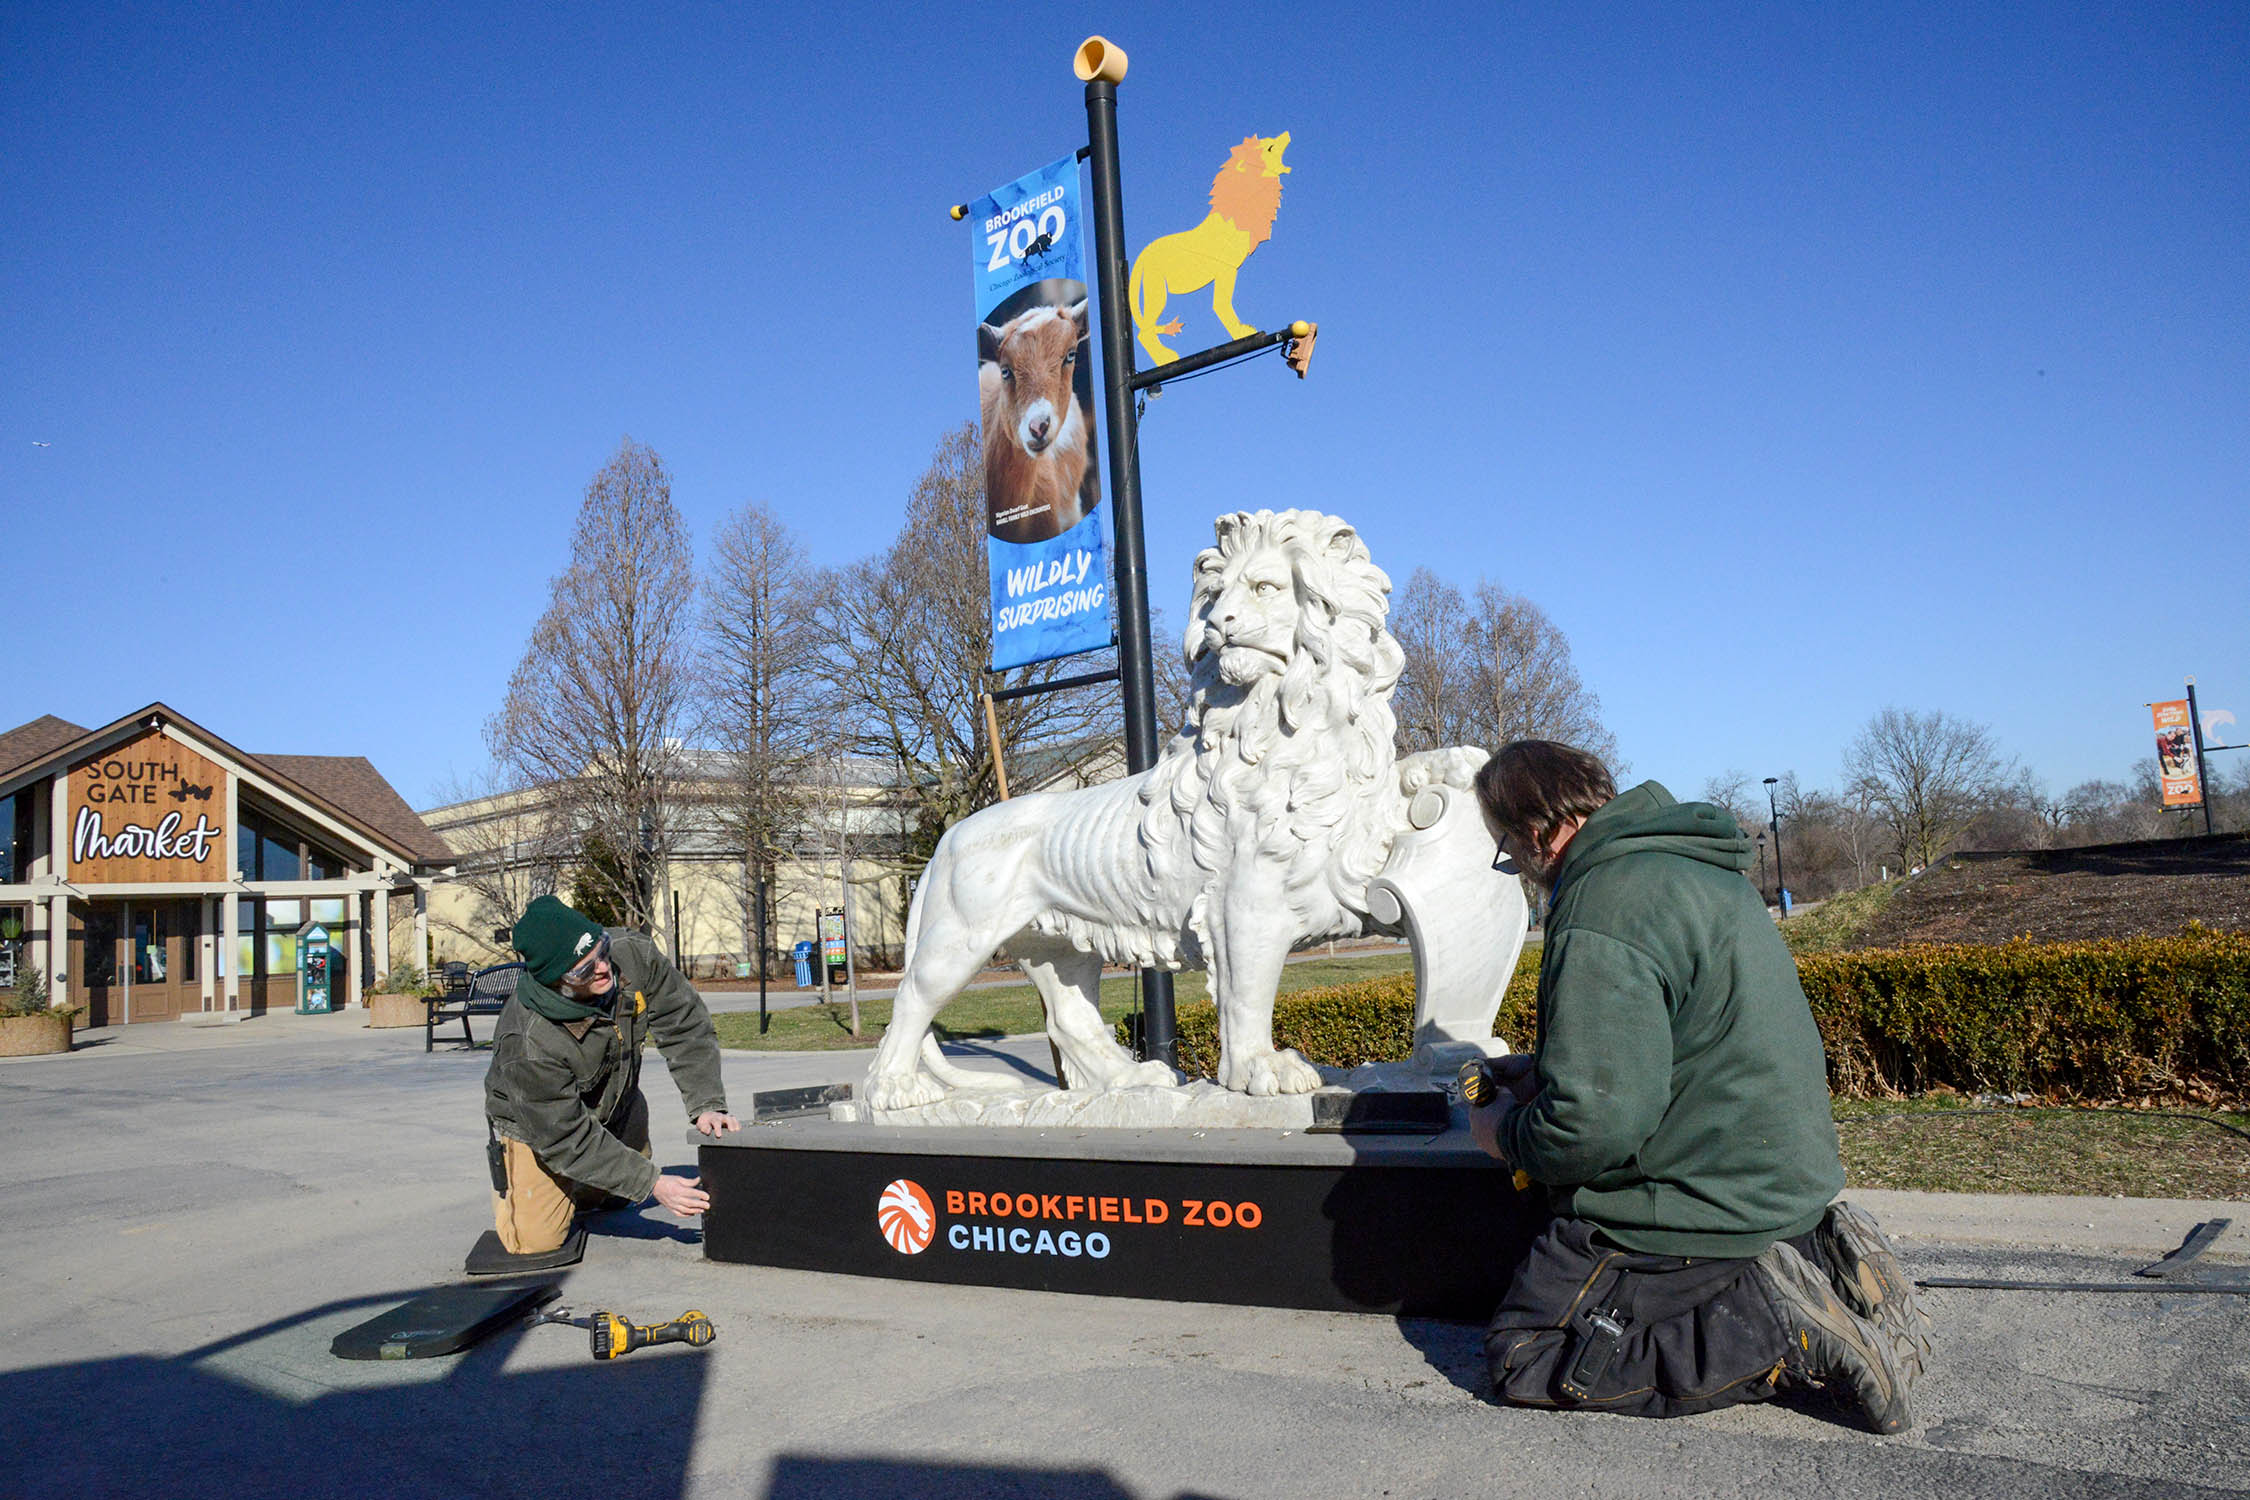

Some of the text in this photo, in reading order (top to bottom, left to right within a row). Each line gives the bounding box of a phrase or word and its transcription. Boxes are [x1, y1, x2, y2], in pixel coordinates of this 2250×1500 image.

[985, 185, 1064, 233] BROOKFIELD
[987, 206, 1066, 272] ZOO
[1007, 549, 1091, 598] WILDLY
[997, 583, 1104, 632] SURPRISING
[87, 760, 178, 782] SOUTH
[2167, 783, 2194, 796] ZOO
[87, 783, 157, 804] GATE
[74, 806, 221, 864] Market
[945, 1190, 1263, 1229] BROOKFIELD ZOO
[948, 1224, 1111, 1259] CHICAGO
